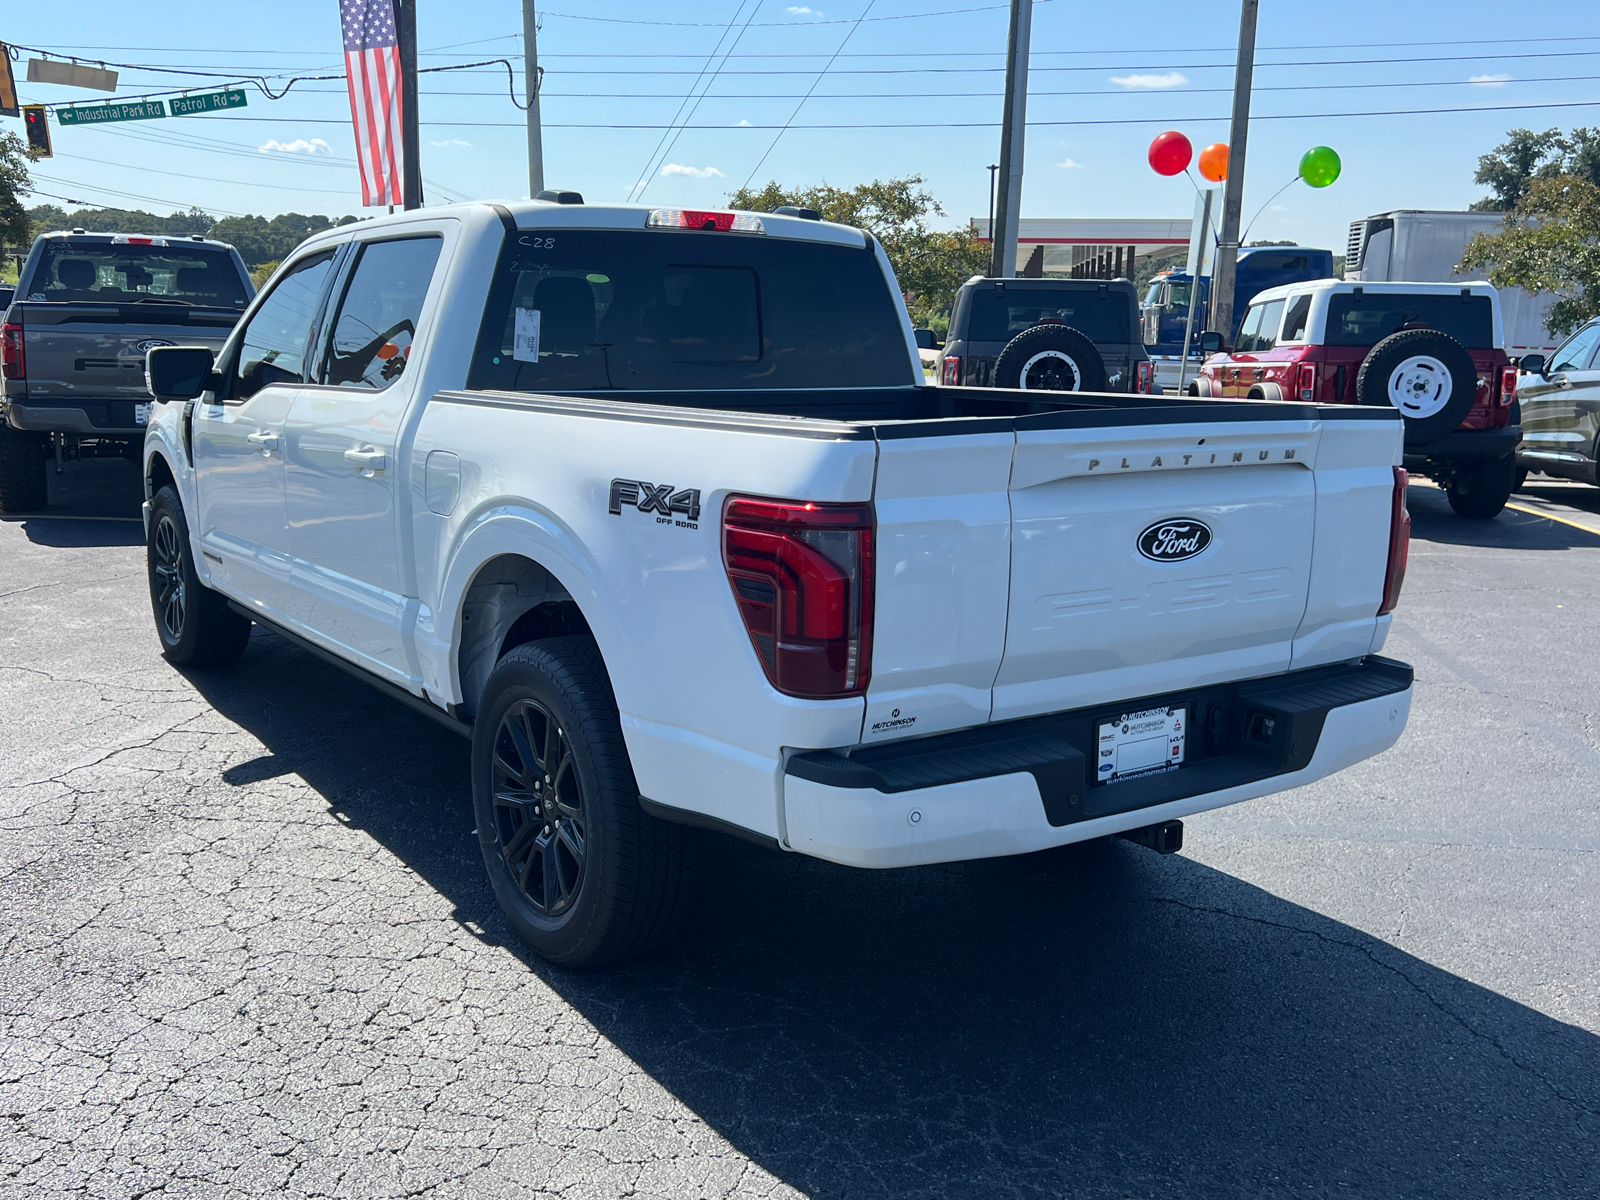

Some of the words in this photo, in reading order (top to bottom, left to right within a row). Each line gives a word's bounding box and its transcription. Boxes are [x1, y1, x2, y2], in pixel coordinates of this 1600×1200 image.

[173, 96, 207, 113] Patrol
[213, 94, 228, 107] Rd
[75, 107, 121, 122] Industrial
[123, 105, 145, 118] Park
[146, 103, 161, 116] Rd
[518, 236, 555, 249] C28
[1088, 449, 1296, 471] PLATINUM
[609, 477, 701, 521] FX4
[656, 517, 673, 526] OFF
[675, 520, 698, 530] ROAD
[1151, 525, 1201, 555] Ford
[1128, 706, 1170, 721] HUTCHINSON
[872, 717, 916, 730] HUTCHINSON
[1130, 719, 1165, 731] HUTCHINSON
